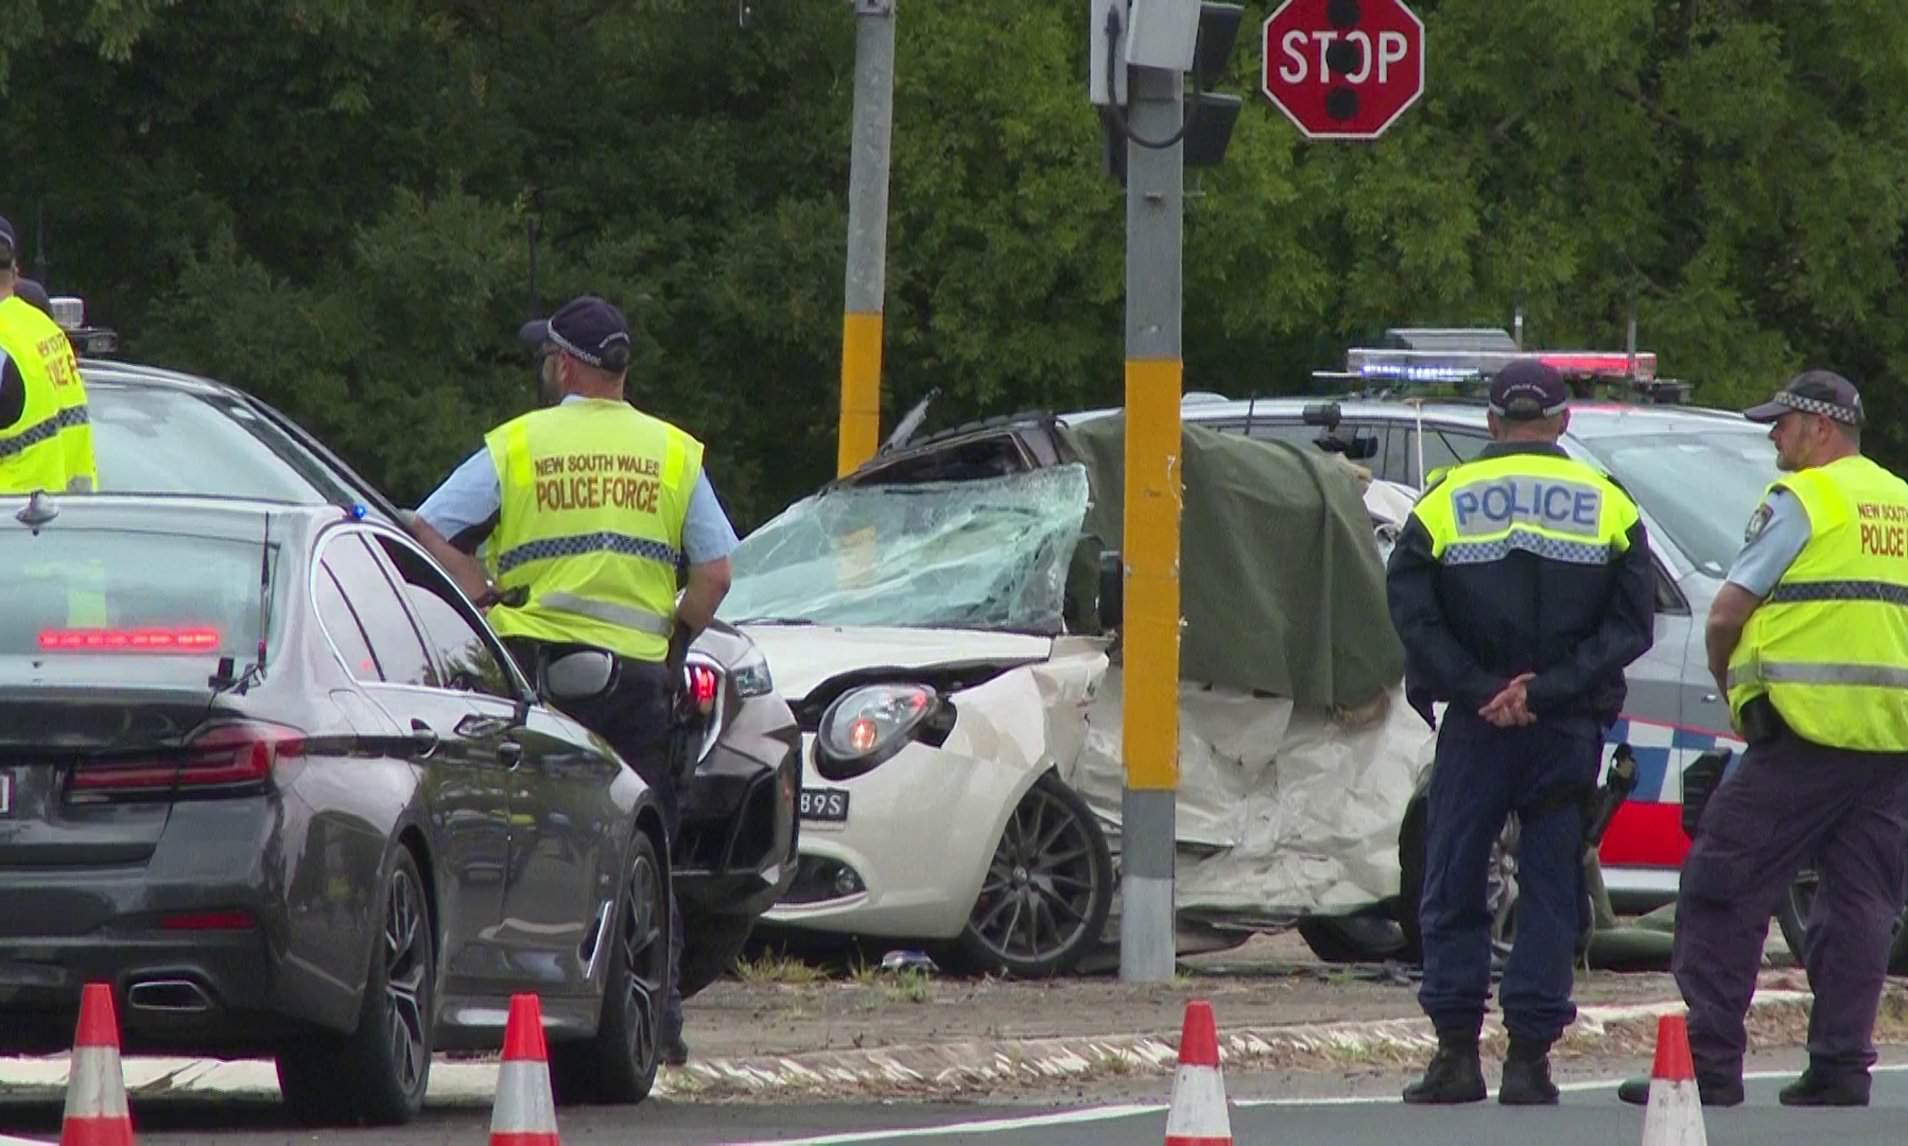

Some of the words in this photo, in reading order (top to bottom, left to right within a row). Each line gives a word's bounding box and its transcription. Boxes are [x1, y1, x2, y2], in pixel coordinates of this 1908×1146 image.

[1279, 30, 1408, 84] STOP
[535, 457, 564, 476] NEW
[567, 454, 613, 472] SOUTH
[617, 455, 659, 476] WALES
[536, 477, 600, 512] POLICE
[602, 478, 659, 513] FORCE
[1455, 482, 1597, 525] POLICE
[1857, 503, 1880, 519] NEW
[1882, 503, 1908, 522] SOUT
[1861, 524, 1904, 557] POLICE
